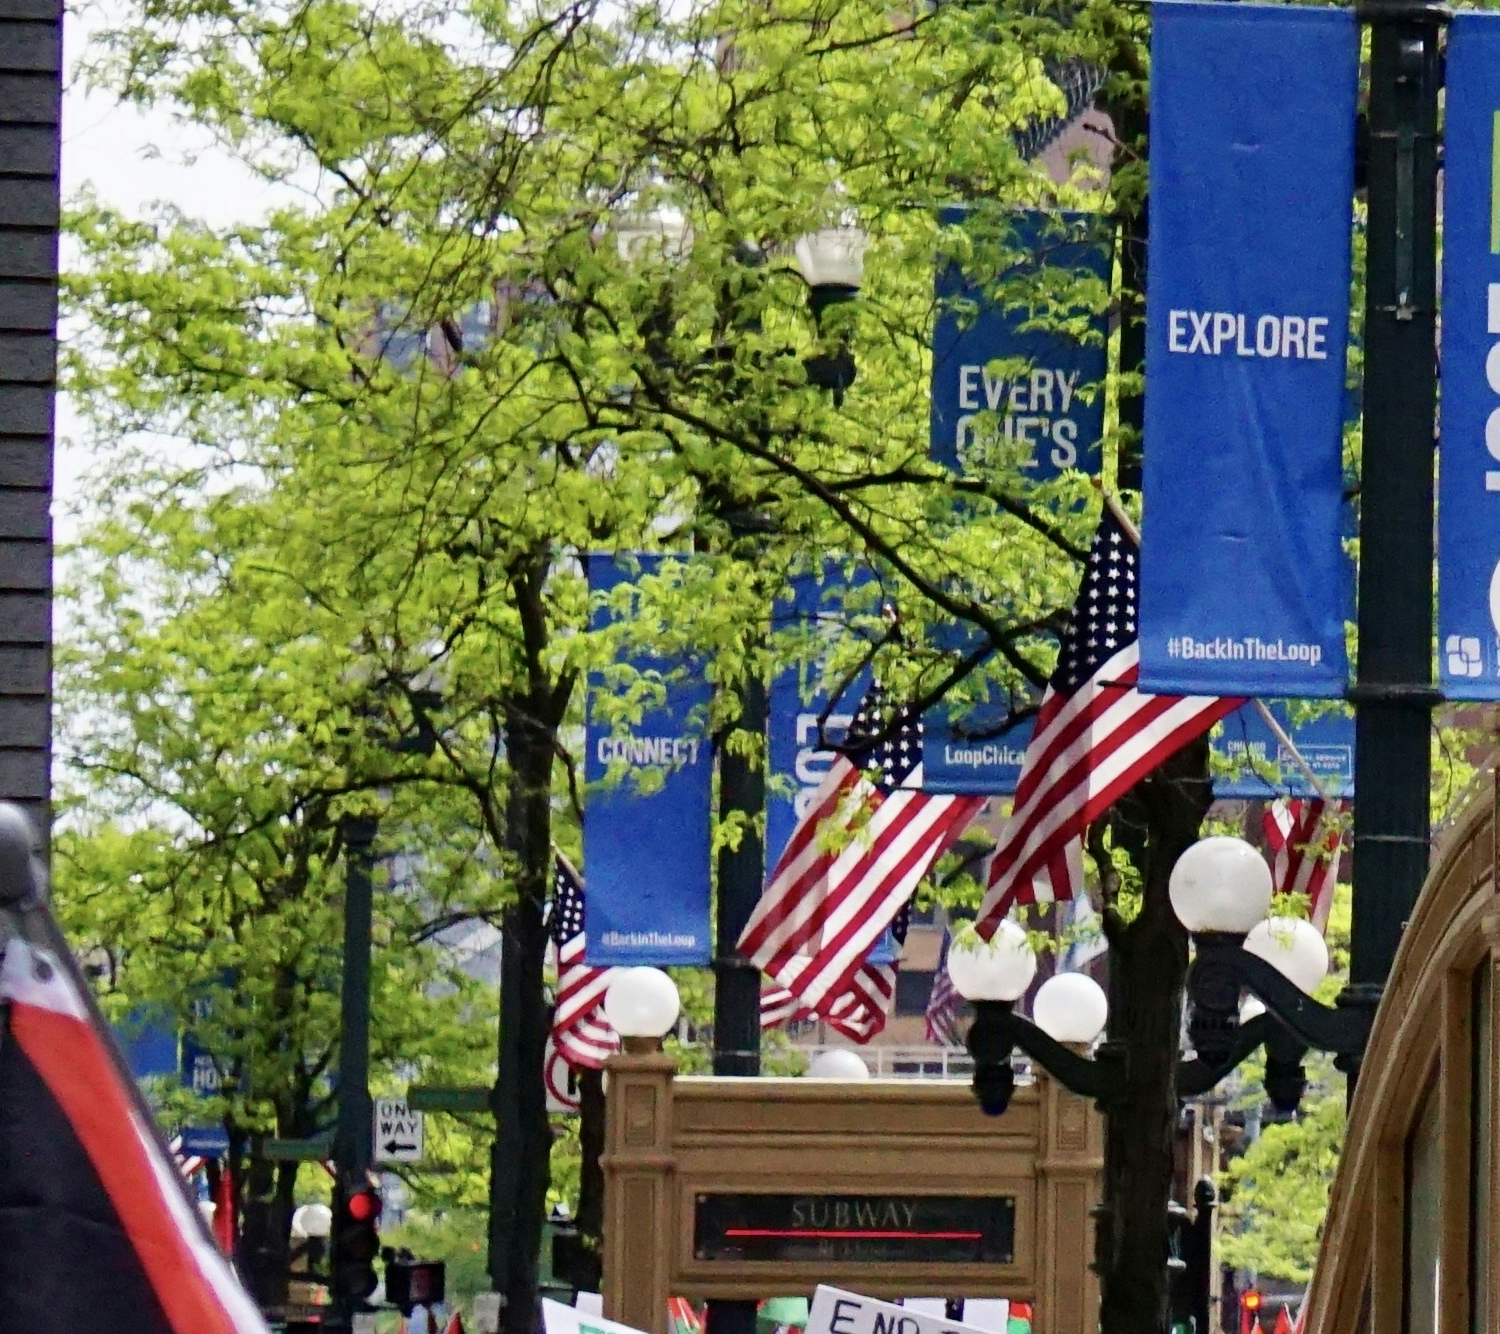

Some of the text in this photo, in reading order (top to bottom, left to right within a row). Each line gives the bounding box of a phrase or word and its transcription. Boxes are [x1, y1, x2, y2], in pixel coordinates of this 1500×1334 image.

[1168, 309, 1330, 360] EXPLORE
[959, 364, 1081, 414] EVERY
[1167, 635, 1322, 666] #BackInTheLoop
[597, 736, 699, 766] CONNECT
[380, 1120, 418, 1135] WAY
[792, 1200, 917, 1228] SUBWAY
